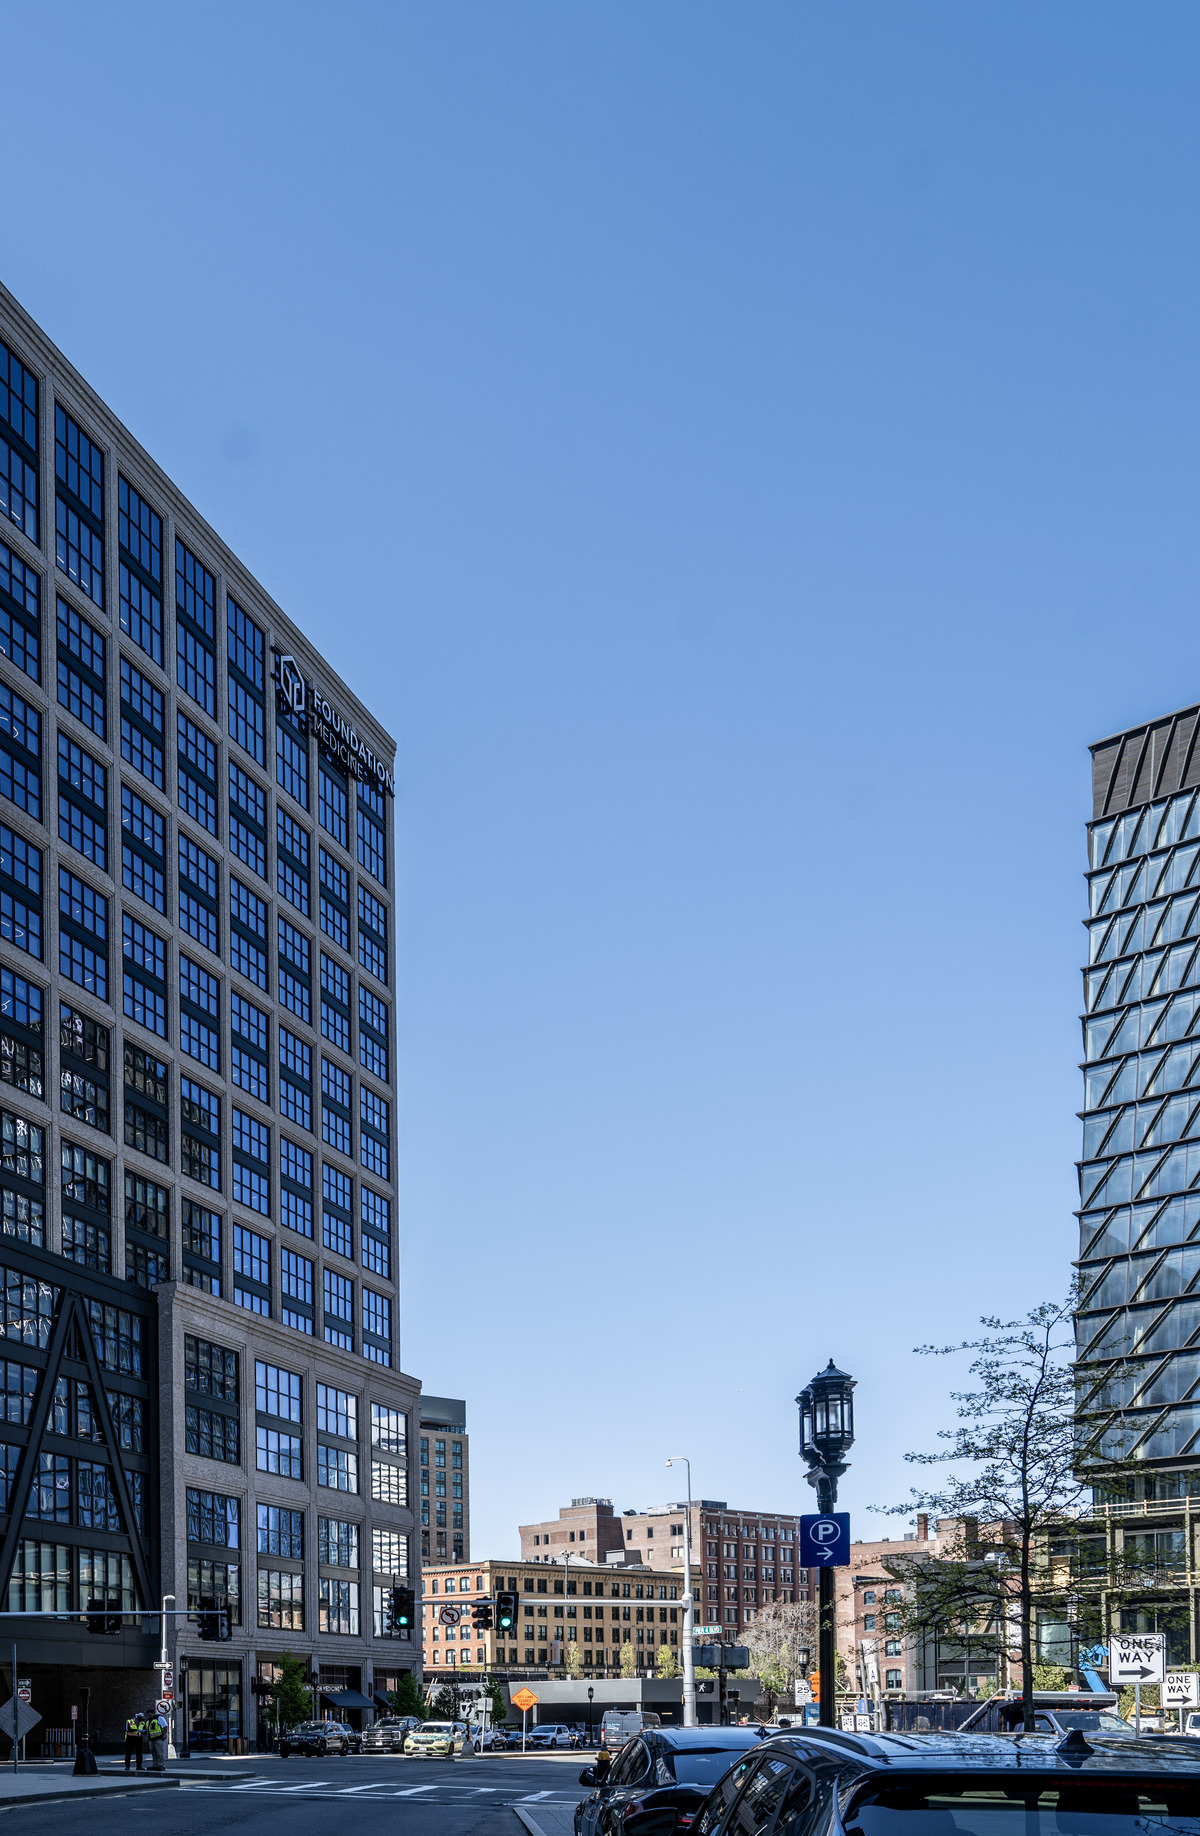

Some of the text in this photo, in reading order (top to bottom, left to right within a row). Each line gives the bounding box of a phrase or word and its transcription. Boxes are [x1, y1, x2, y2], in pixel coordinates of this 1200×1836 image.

[313, 689, 396, 792] FOUNDATION
[313, 718, 364, 782] MEDICINE
[818, 1523, 834, 1541] P
[1120, 1638, 1153, 1650] ONE
[1119, 1651, 1154, 1663] WAY
[1167, 1675, 1191, 1684] ONE
[1167, 1684, 1192, 1694] WAY
